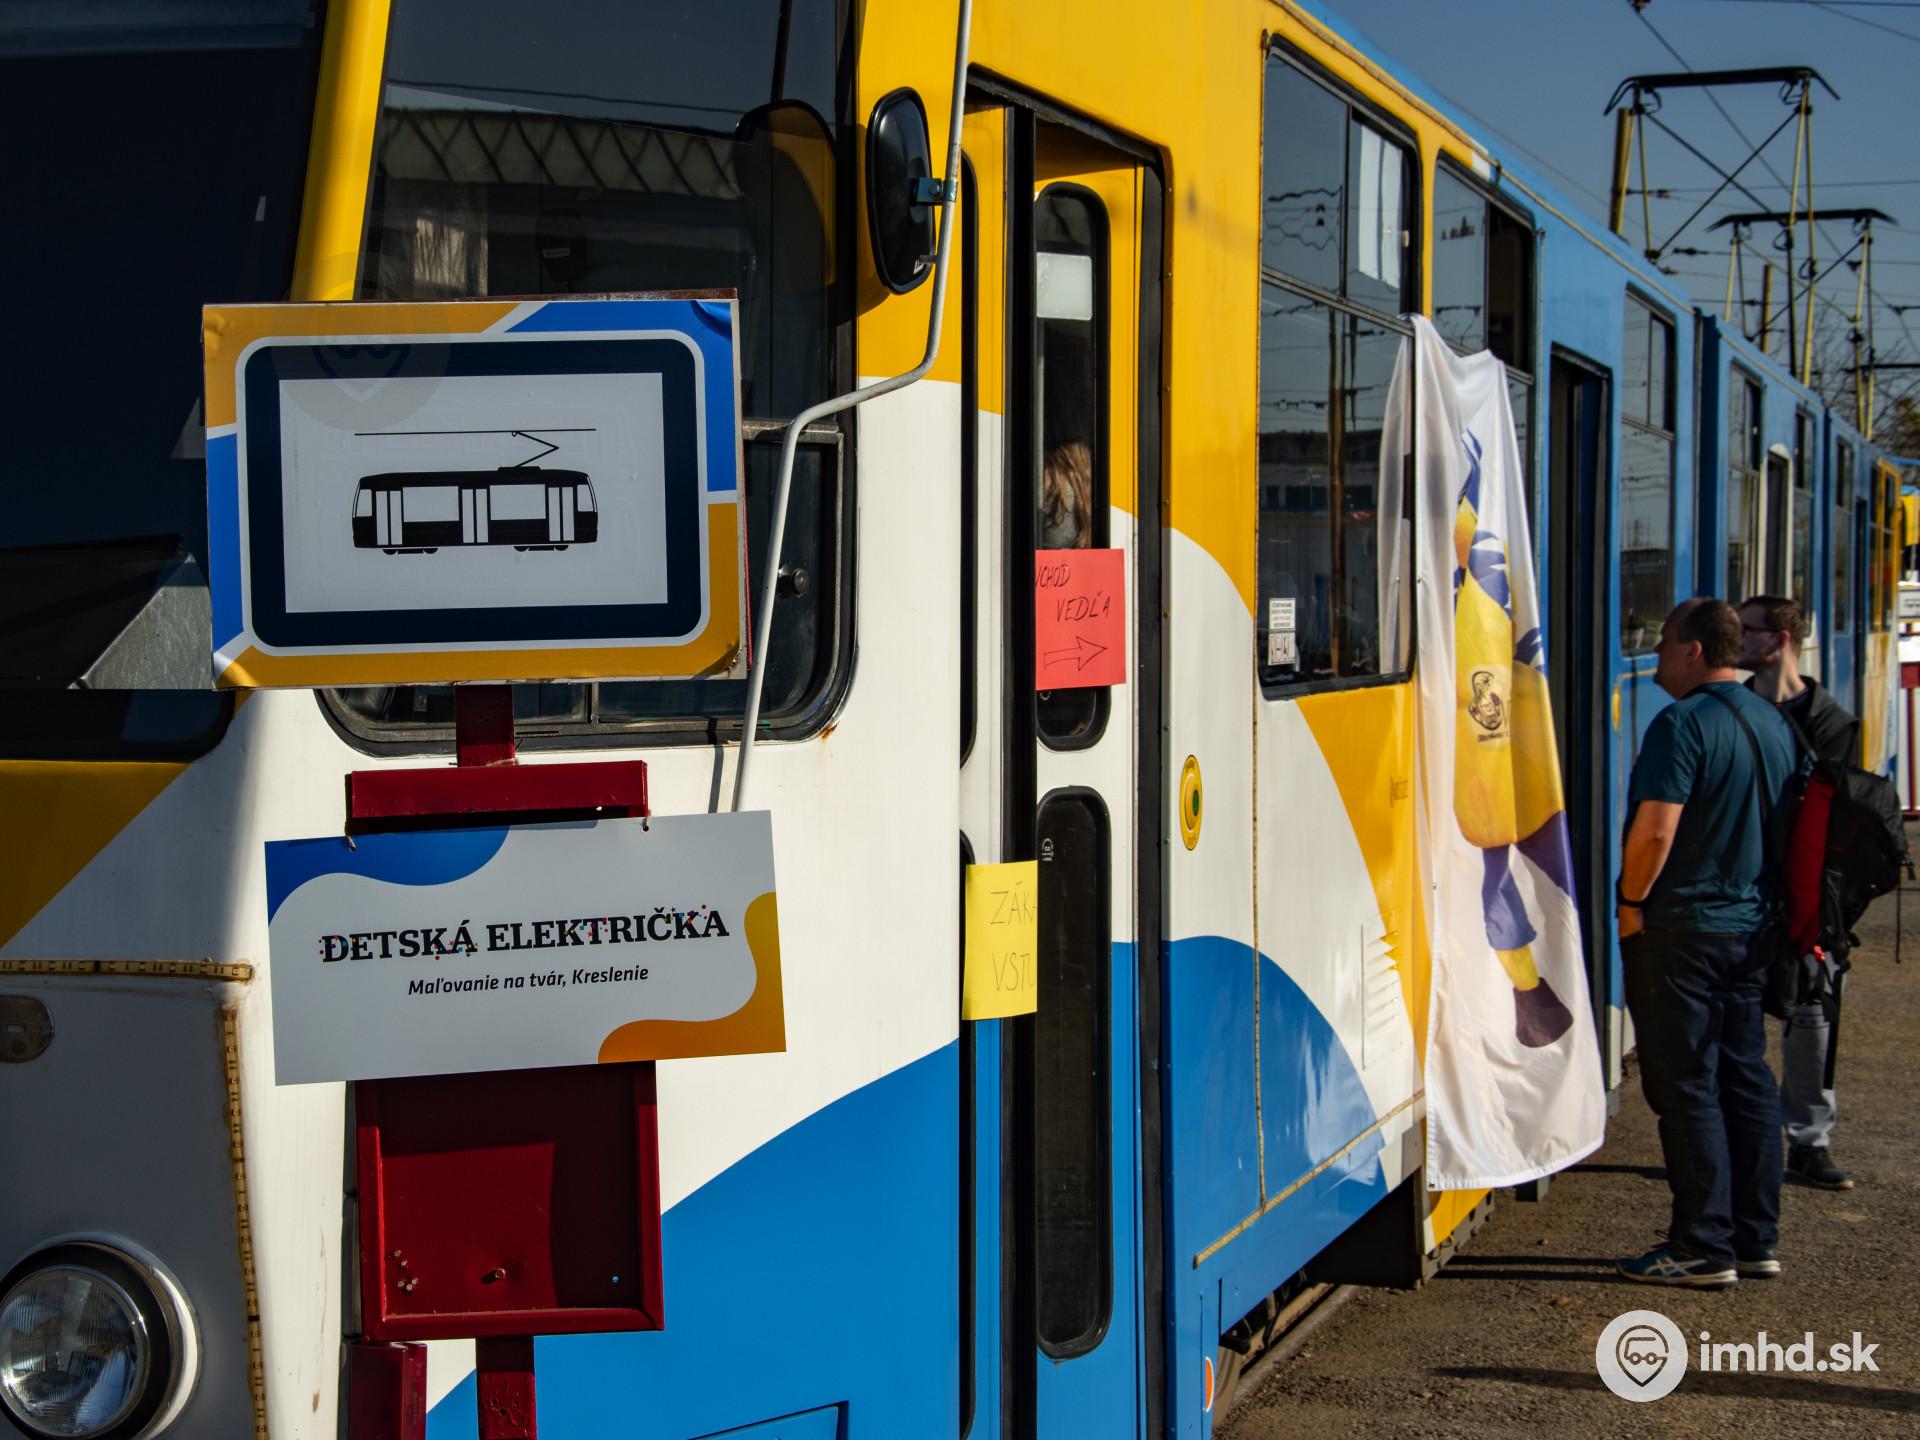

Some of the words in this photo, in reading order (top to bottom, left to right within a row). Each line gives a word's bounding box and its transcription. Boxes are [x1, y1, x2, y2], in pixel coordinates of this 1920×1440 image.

[990, 881, 1038, 926] ZÁK
[321, 919, 479, 963] DETSKÁ
[486, 905, 730, 952] ELEKTRIČKA
[407, 974, 500, 996] Maľovanie
[503, 974, 526, 989] na
[529, 969, 567, 989] tvár,
[571, 964, 649, 985] Kreslenie
